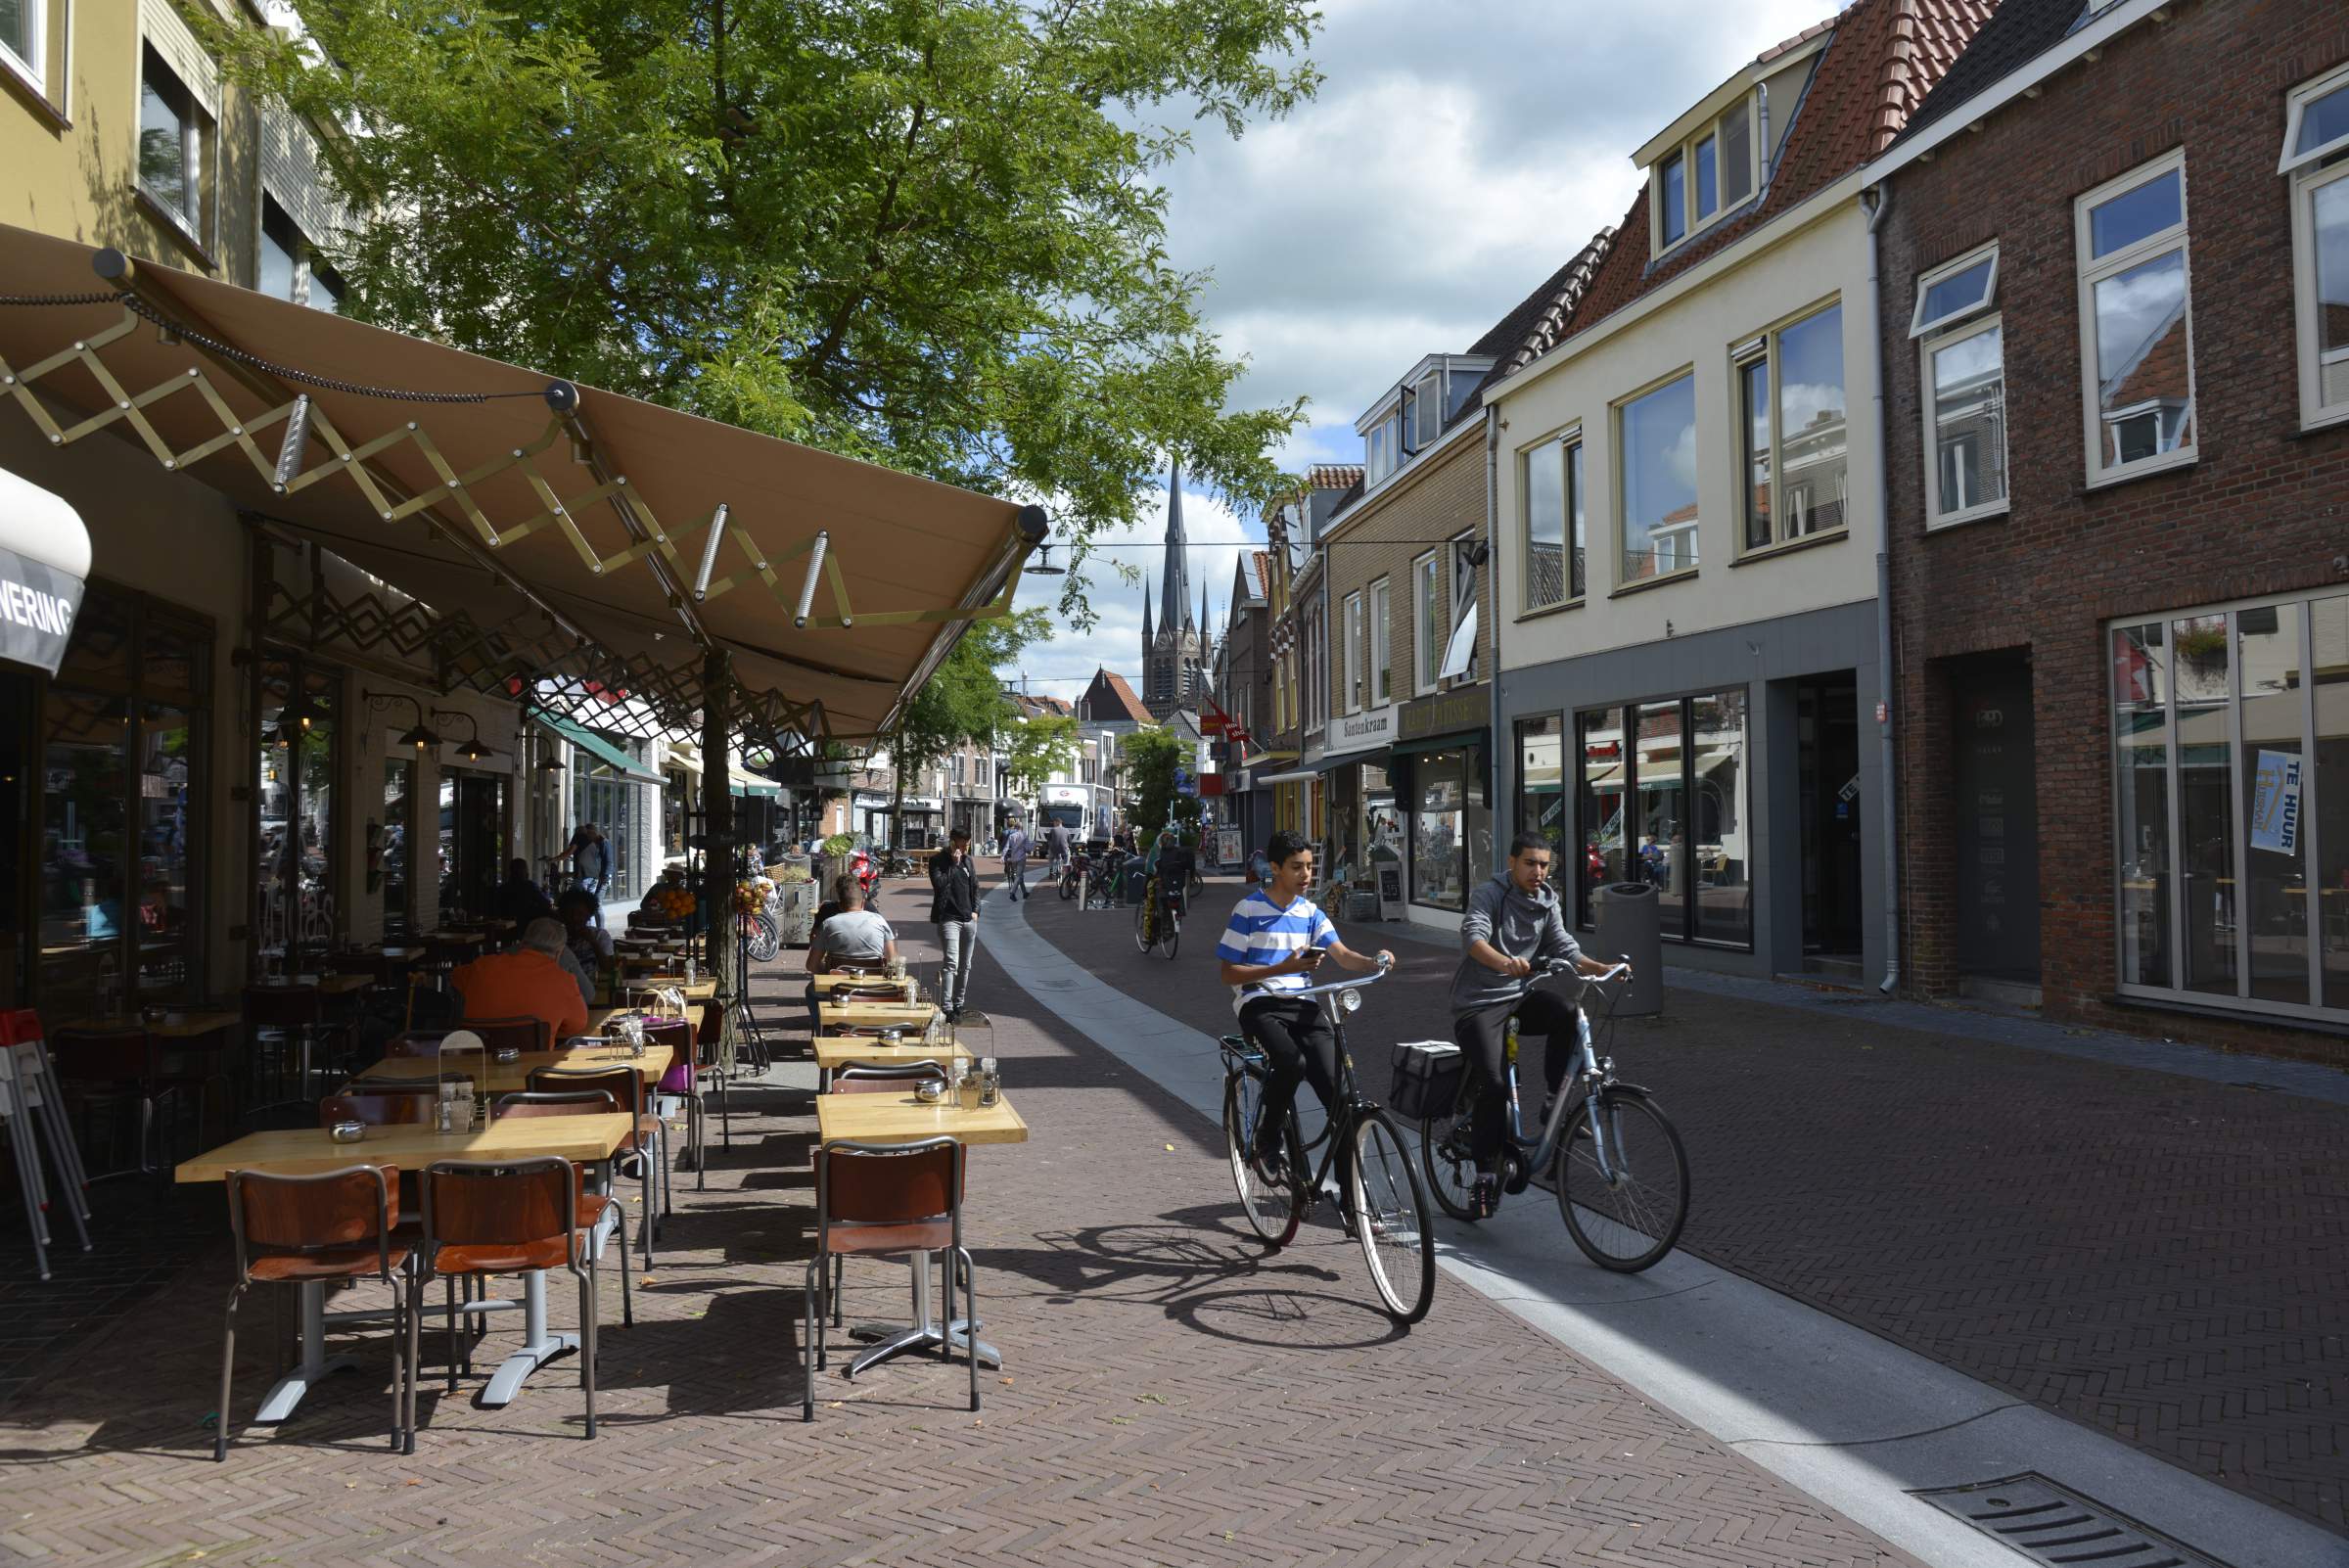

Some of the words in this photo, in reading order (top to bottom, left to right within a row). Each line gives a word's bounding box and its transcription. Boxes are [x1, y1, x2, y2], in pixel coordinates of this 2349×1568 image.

[1344, 716, 1388, 737] Santenkraam
[2286, 761, 2300, 786] TE
[2281, 794, 2298, 849] HUUR
